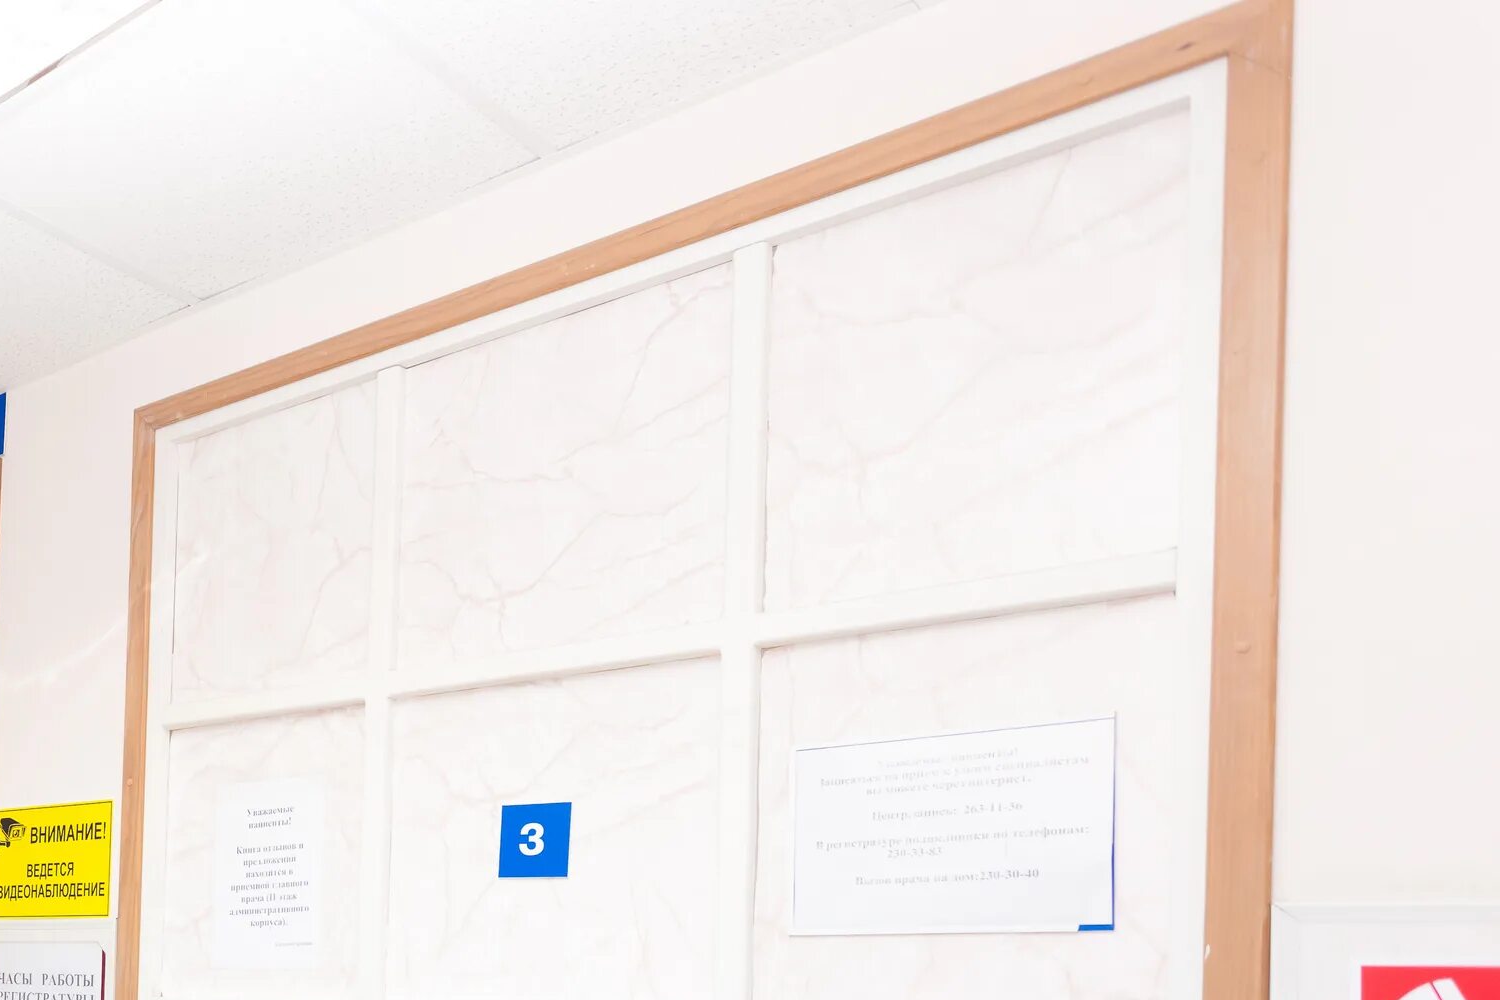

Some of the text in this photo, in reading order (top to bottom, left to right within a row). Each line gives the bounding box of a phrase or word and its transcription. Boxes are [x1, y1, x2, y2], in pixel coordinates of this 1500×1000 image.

[246, 806, 294, 816] Уважаемые
[30, 822, 106, 844] ВНИМАНИЕ!
[518, 822, 544, 856] 3
[236, 845, 260, 854] Книга
[27, 862, 74, 880] ВЕДЕТСЯ
[241, 895, 264, 904] врача
[42, 974, 94, 987] РАБОТЫ
